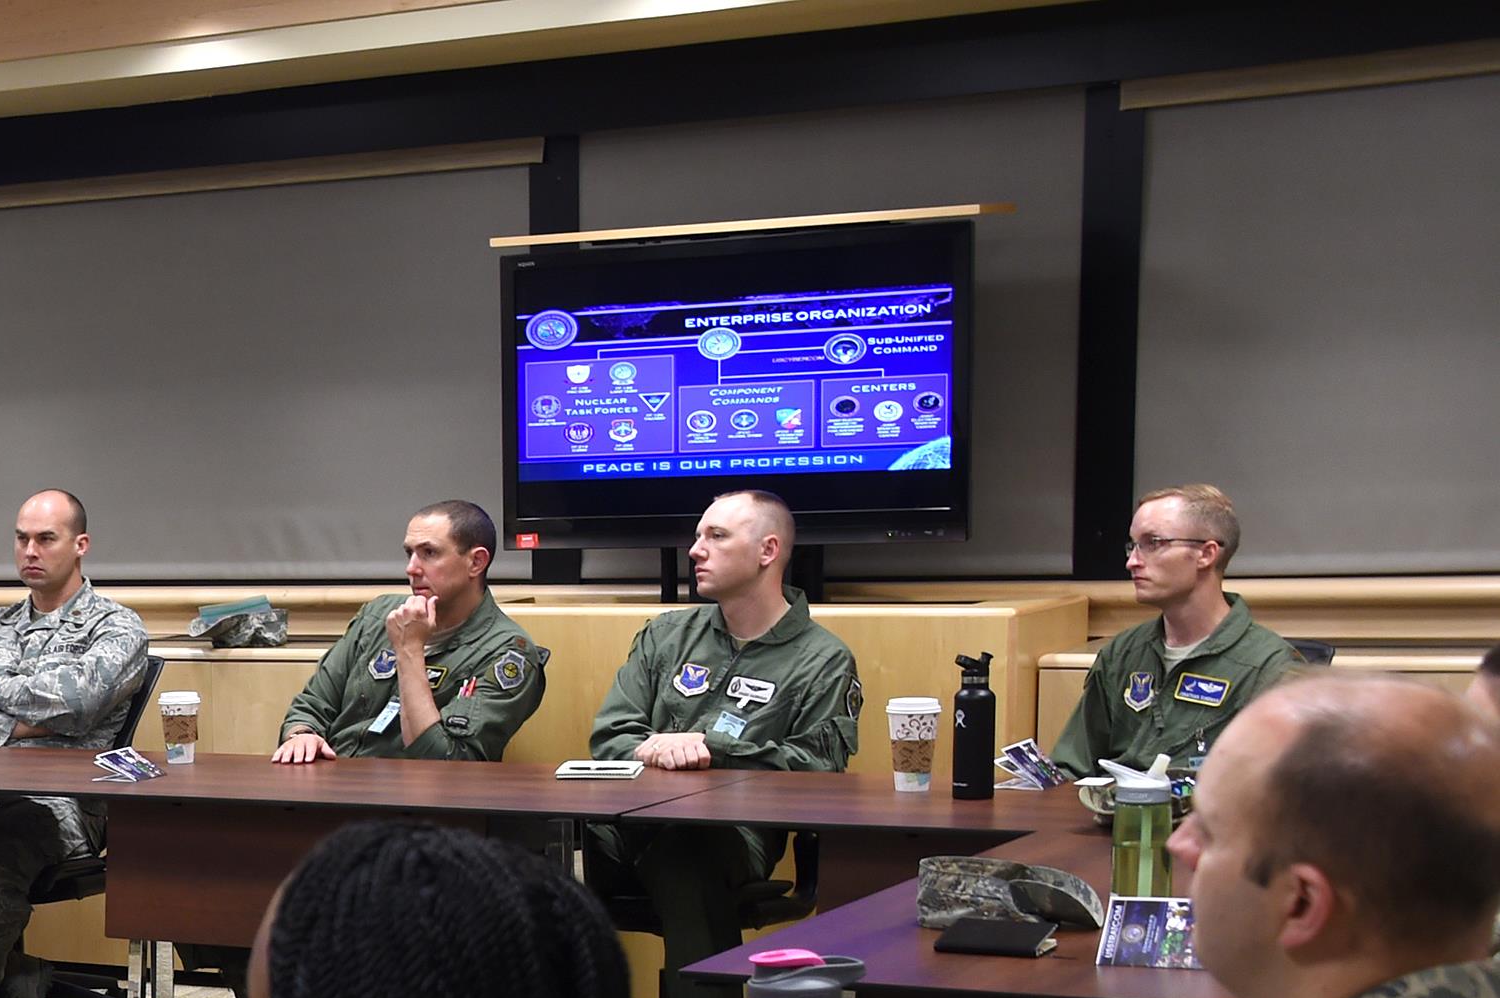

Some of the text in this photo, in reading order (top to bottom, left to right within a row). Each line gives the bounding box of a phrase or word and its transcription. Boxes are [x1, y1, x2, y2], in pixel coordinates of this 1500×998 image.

[684, 303, 932, 329] ENTERPRISE ORGANIZATION
[851, 382, 917, 393] CENTERS
[583, 454, 864, 473] PEACE IS OUR PROFESSION
[53, 645, 64, 654] AIR
